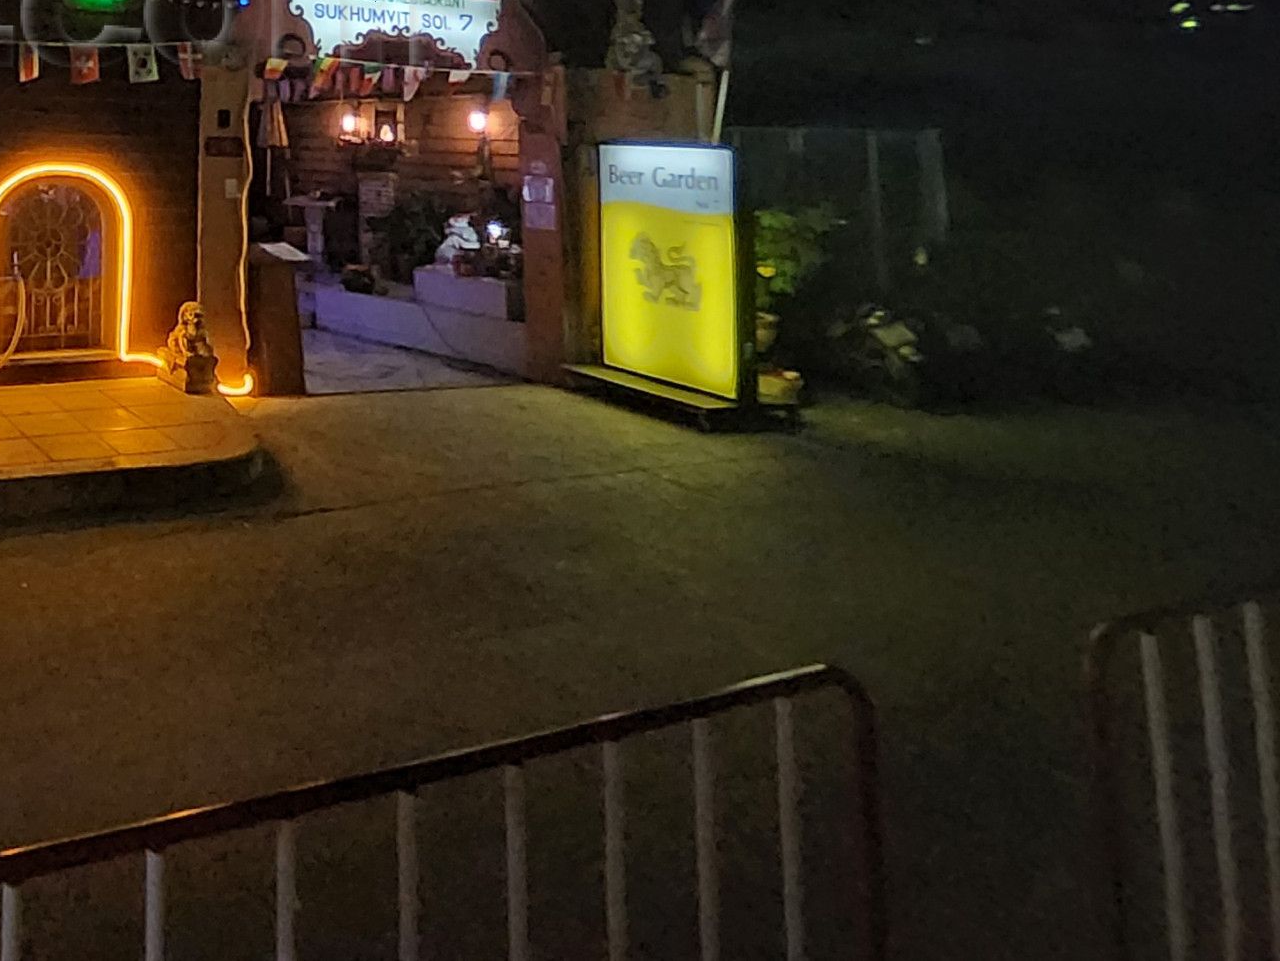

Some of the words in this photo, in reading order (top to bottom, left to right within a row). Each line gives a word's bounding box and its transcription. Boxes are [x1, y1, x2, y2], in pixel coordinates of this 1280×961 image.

[314, 3, 410, 25] SUKHUMVIT
[459, 14, 473, 31] 7
[608, 164, 645, 185] Beer
[652, 167, 718, 191] Garden
